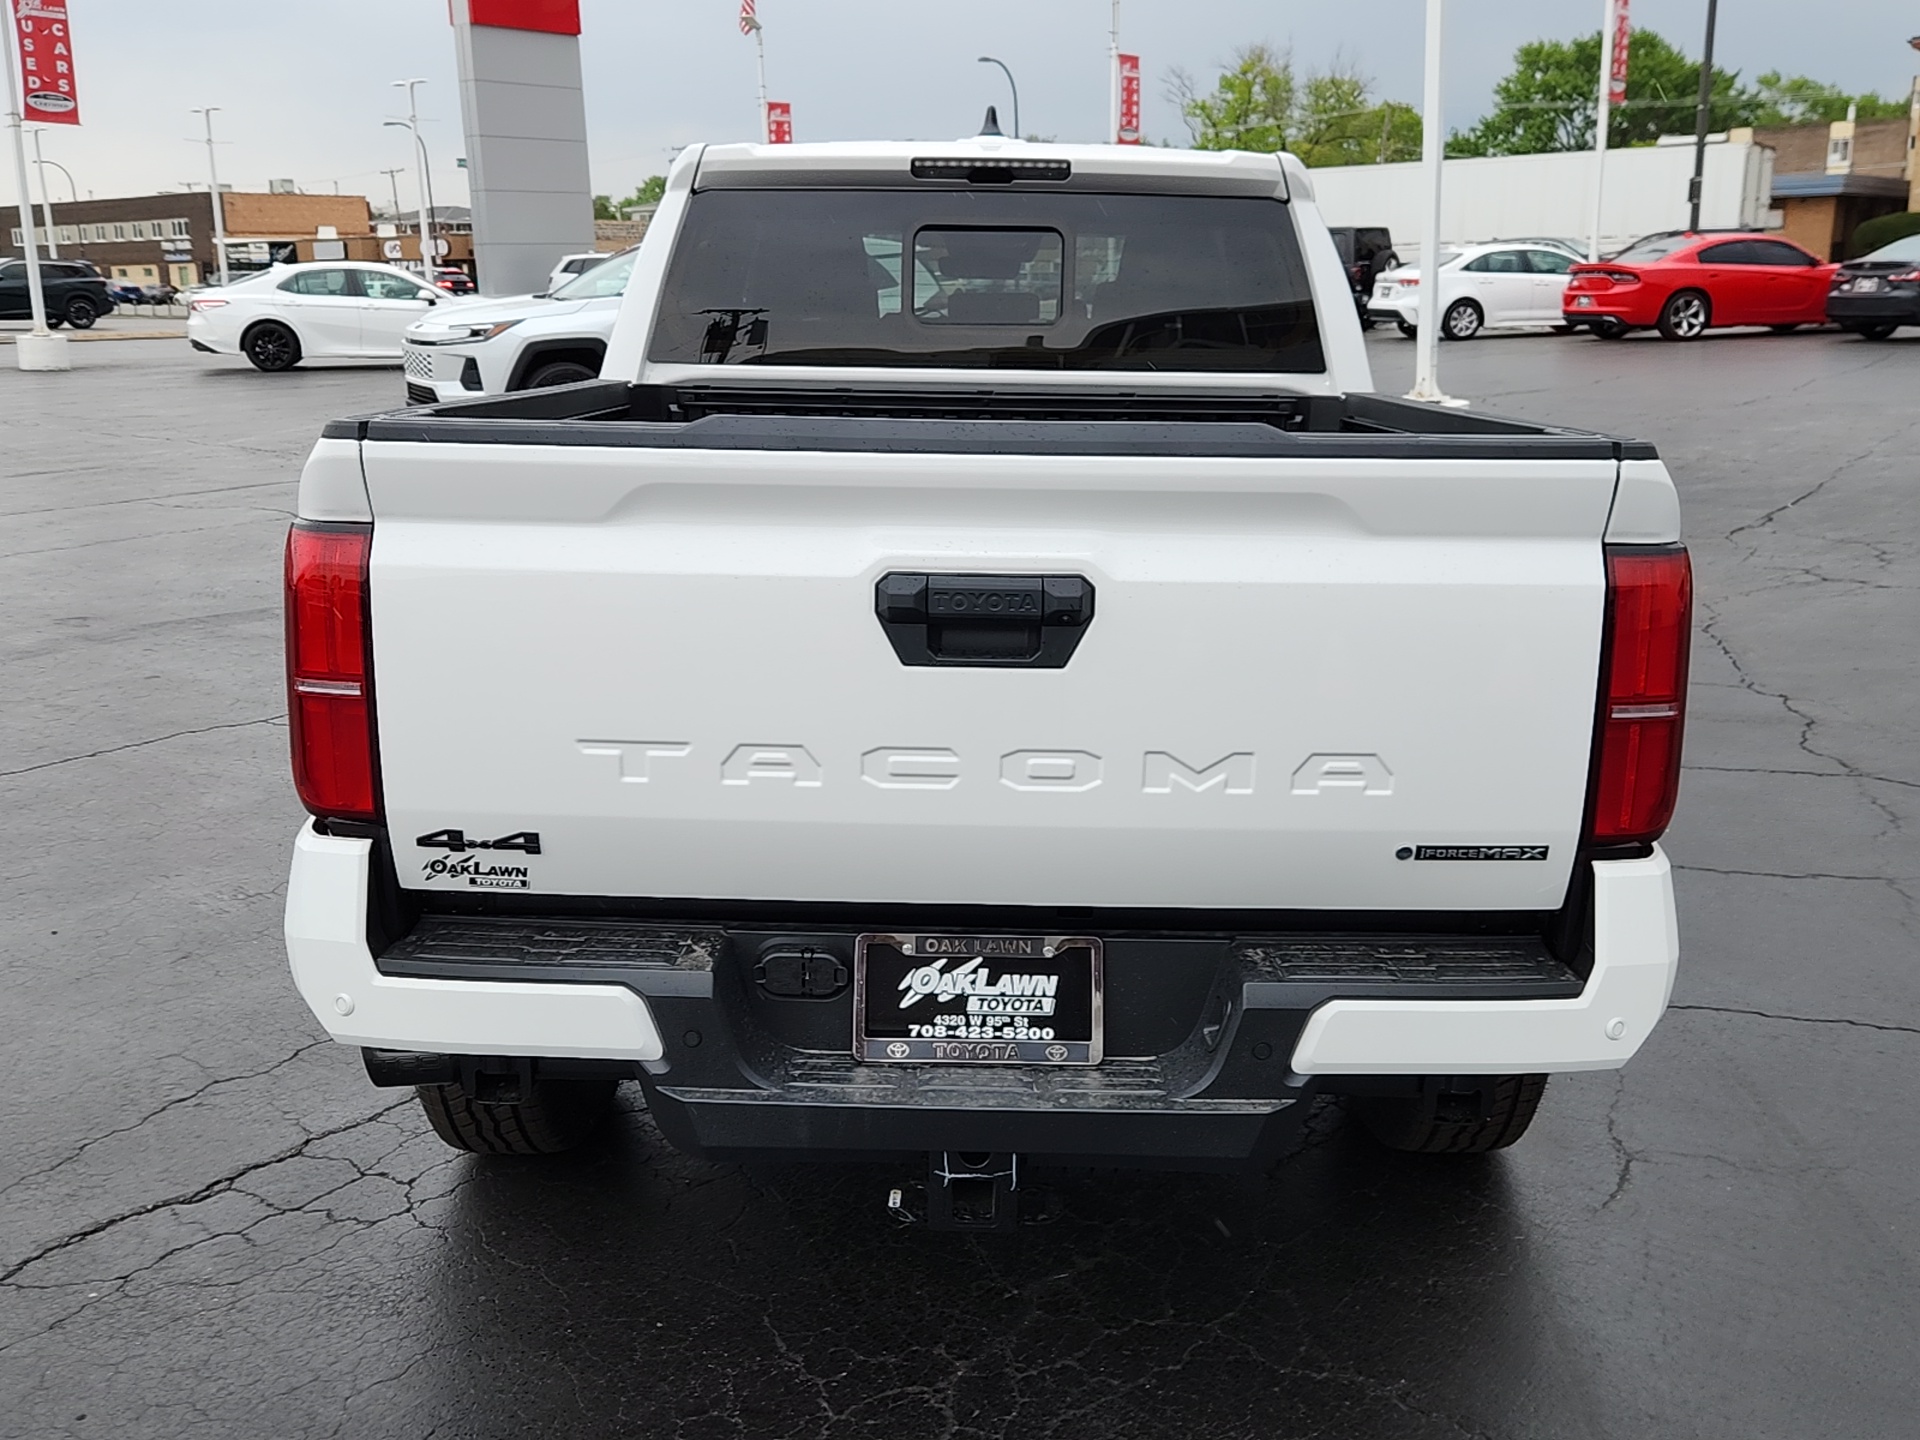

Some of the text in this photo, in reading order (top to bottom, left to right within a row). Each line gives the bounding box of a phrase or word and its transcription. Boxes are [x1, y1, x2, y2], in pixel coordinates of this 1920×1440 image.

[20, 19, 41, 89] USED
[51, 23, 70, 92] CARS
[932, 592, 1038, 613] TOYOTA
[576, 738, 1395, 796] TACOMA
[476, 877, 522, 887] TOYOTA
[925, 938, 1032, 954] OAK LAWN
[976, 997, 1045, 1012] TOYOTA
[933, 1015, 966, 1026] 4320
[968, 1015, 983, 1027] W
[1013, 1016, 1029, 1028] St
[908, 1024, 1055, 1040] 708-423-5200
[932, 1042, 1021, 1060] TOYOTA
